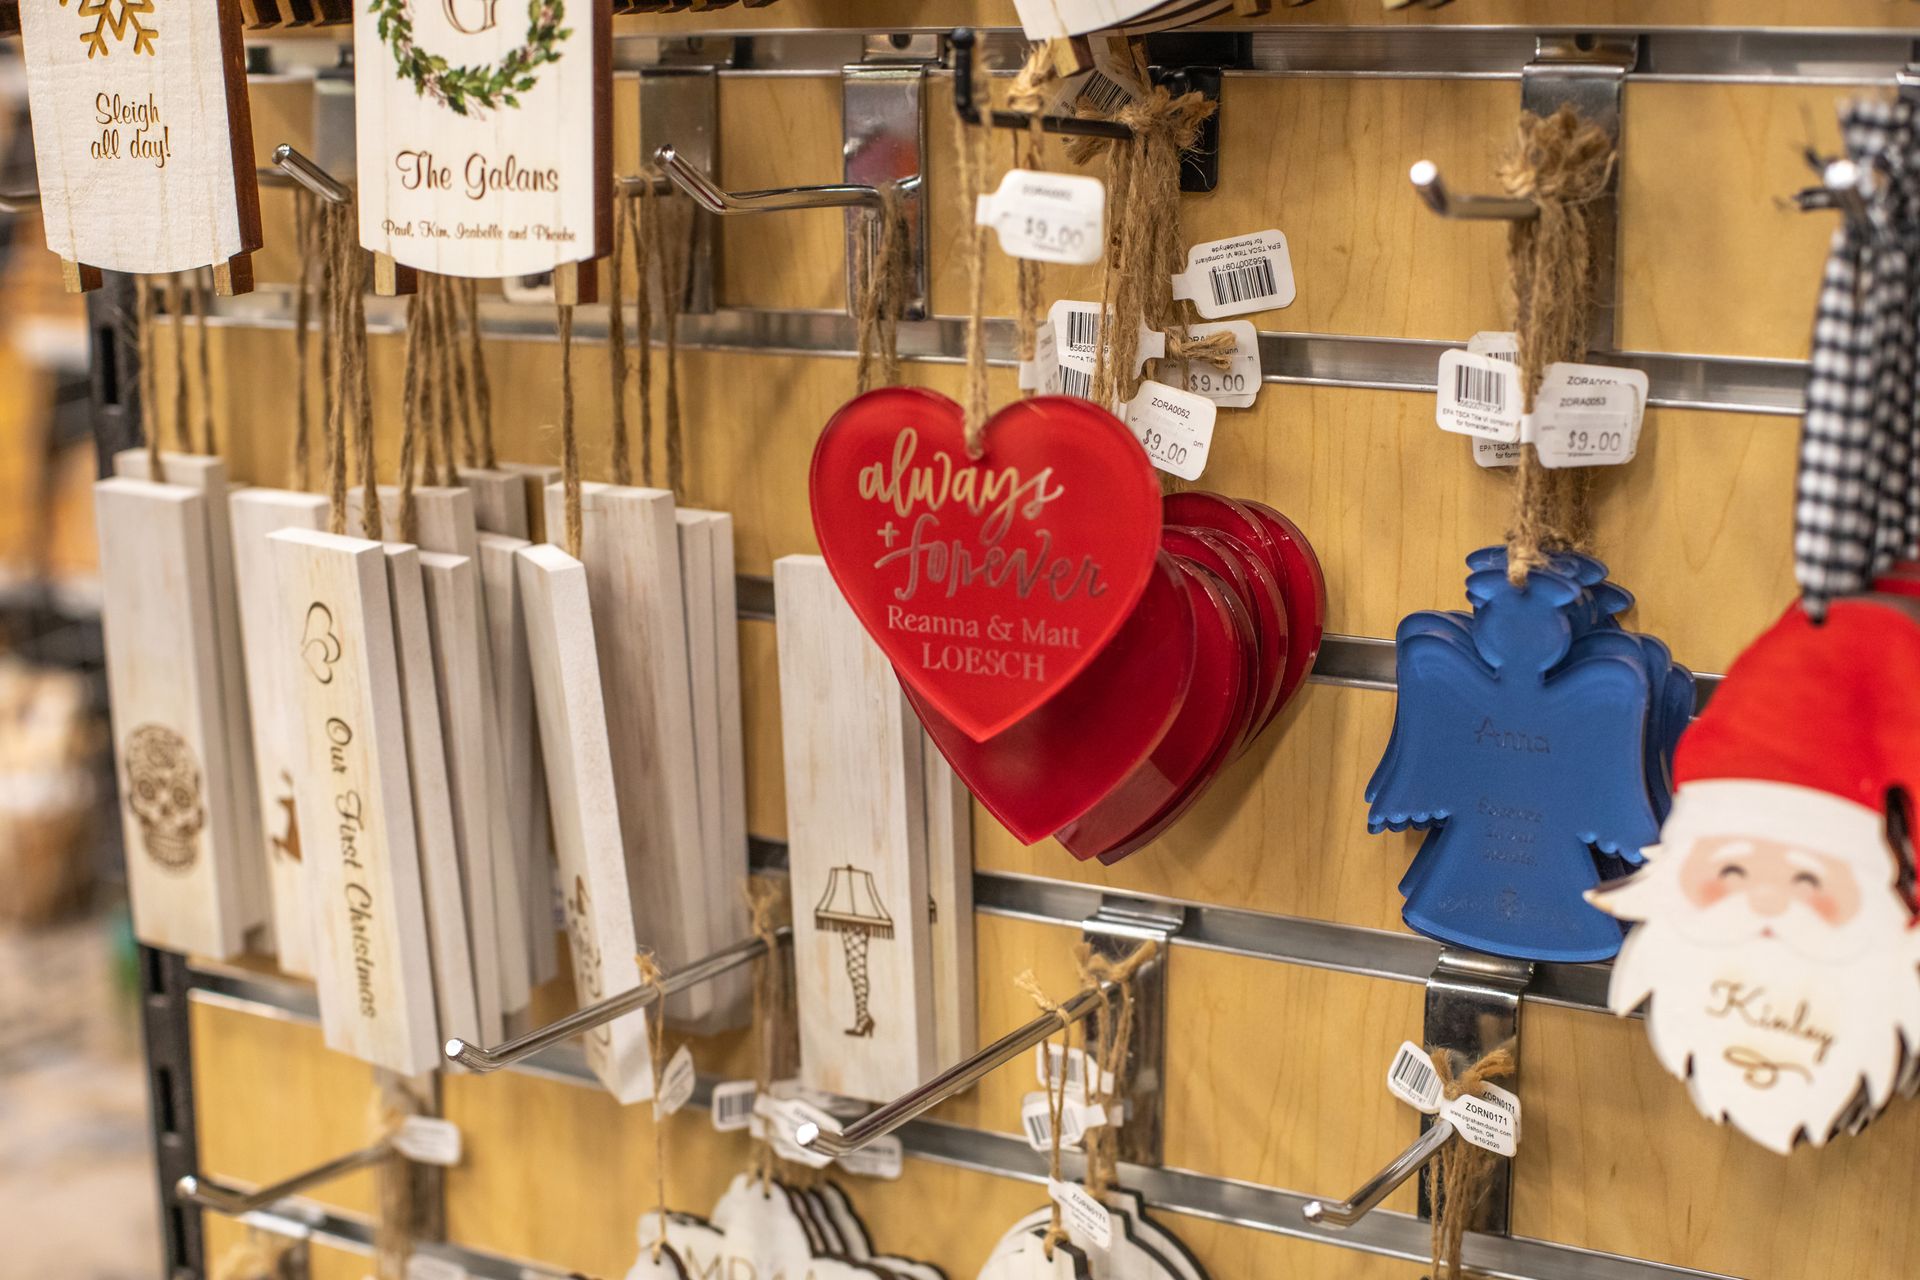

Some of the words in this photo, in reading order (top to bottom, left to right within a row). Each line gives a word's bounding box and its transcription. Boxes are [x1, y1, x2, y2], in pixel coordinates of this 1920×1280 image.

[95, 92, 160, 132] Sleigh
[91, 129, 120, 159] all
[130, 126, 171, 168] day!
[395, 150, 452, 190] The
[464, 152, 559, 200] Galans
[381, 219, 414, 238] Paul,
[418, 220, 450, 239] Kim,
[507, 226, 528, 240] and
[1190, 374, 1245, 392] $9.00
[1151, 397, 1191, 419] ZORA0052
[1142, 428, 1188, 465] $9.00
[1567, 430, 1621, 452] $9.00
[858, 427, 1065, 546] always
[874, 513, 1107, 601] forever
[887, 605, 980, 639] Reanna
[987, 615, 1014, 642] &
[1022, 618, 1082, 648] Matt
[921, 642, 1047, 681] LOESCH
[326, 717, 352, 774] Our
[335, 790, 363, 868] First
[345, 881, 377, 1019] Christmas
[1705, 979, 1837, 1065] Kinley
[1465, 1102, 1509, 1127] ZORN0171
